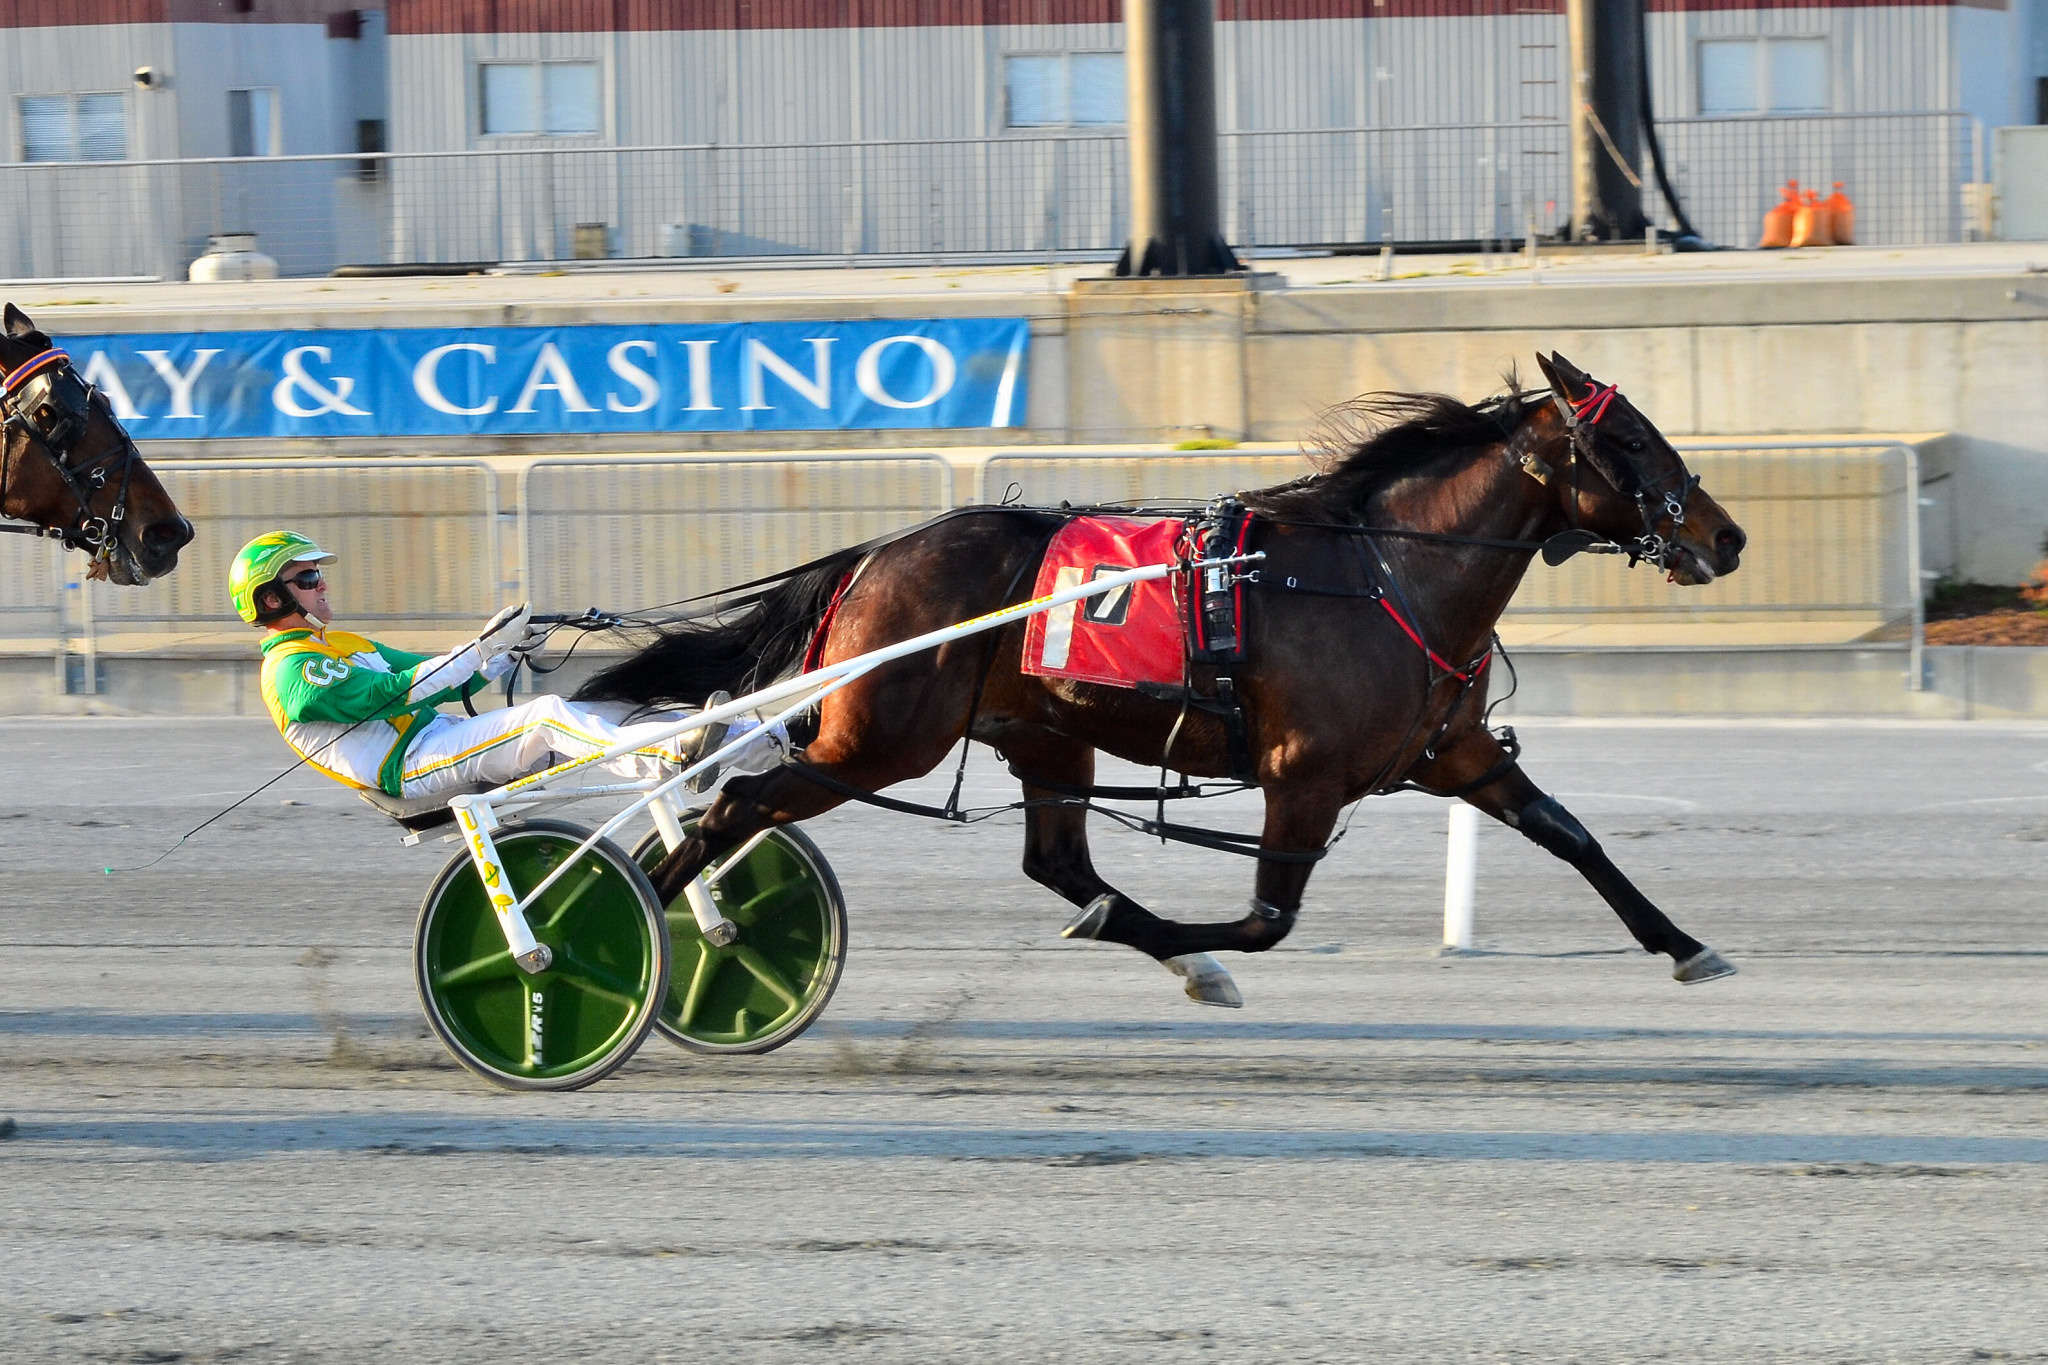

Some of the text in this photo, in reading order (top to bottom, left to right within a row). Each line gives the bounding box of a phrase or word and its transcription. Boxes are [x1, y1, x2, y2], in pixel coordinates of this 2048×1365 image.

[272, 345, 374, 417] &
[413, 335, 957, 417] CASINO
[1093, 569, 1130, 618] 7
